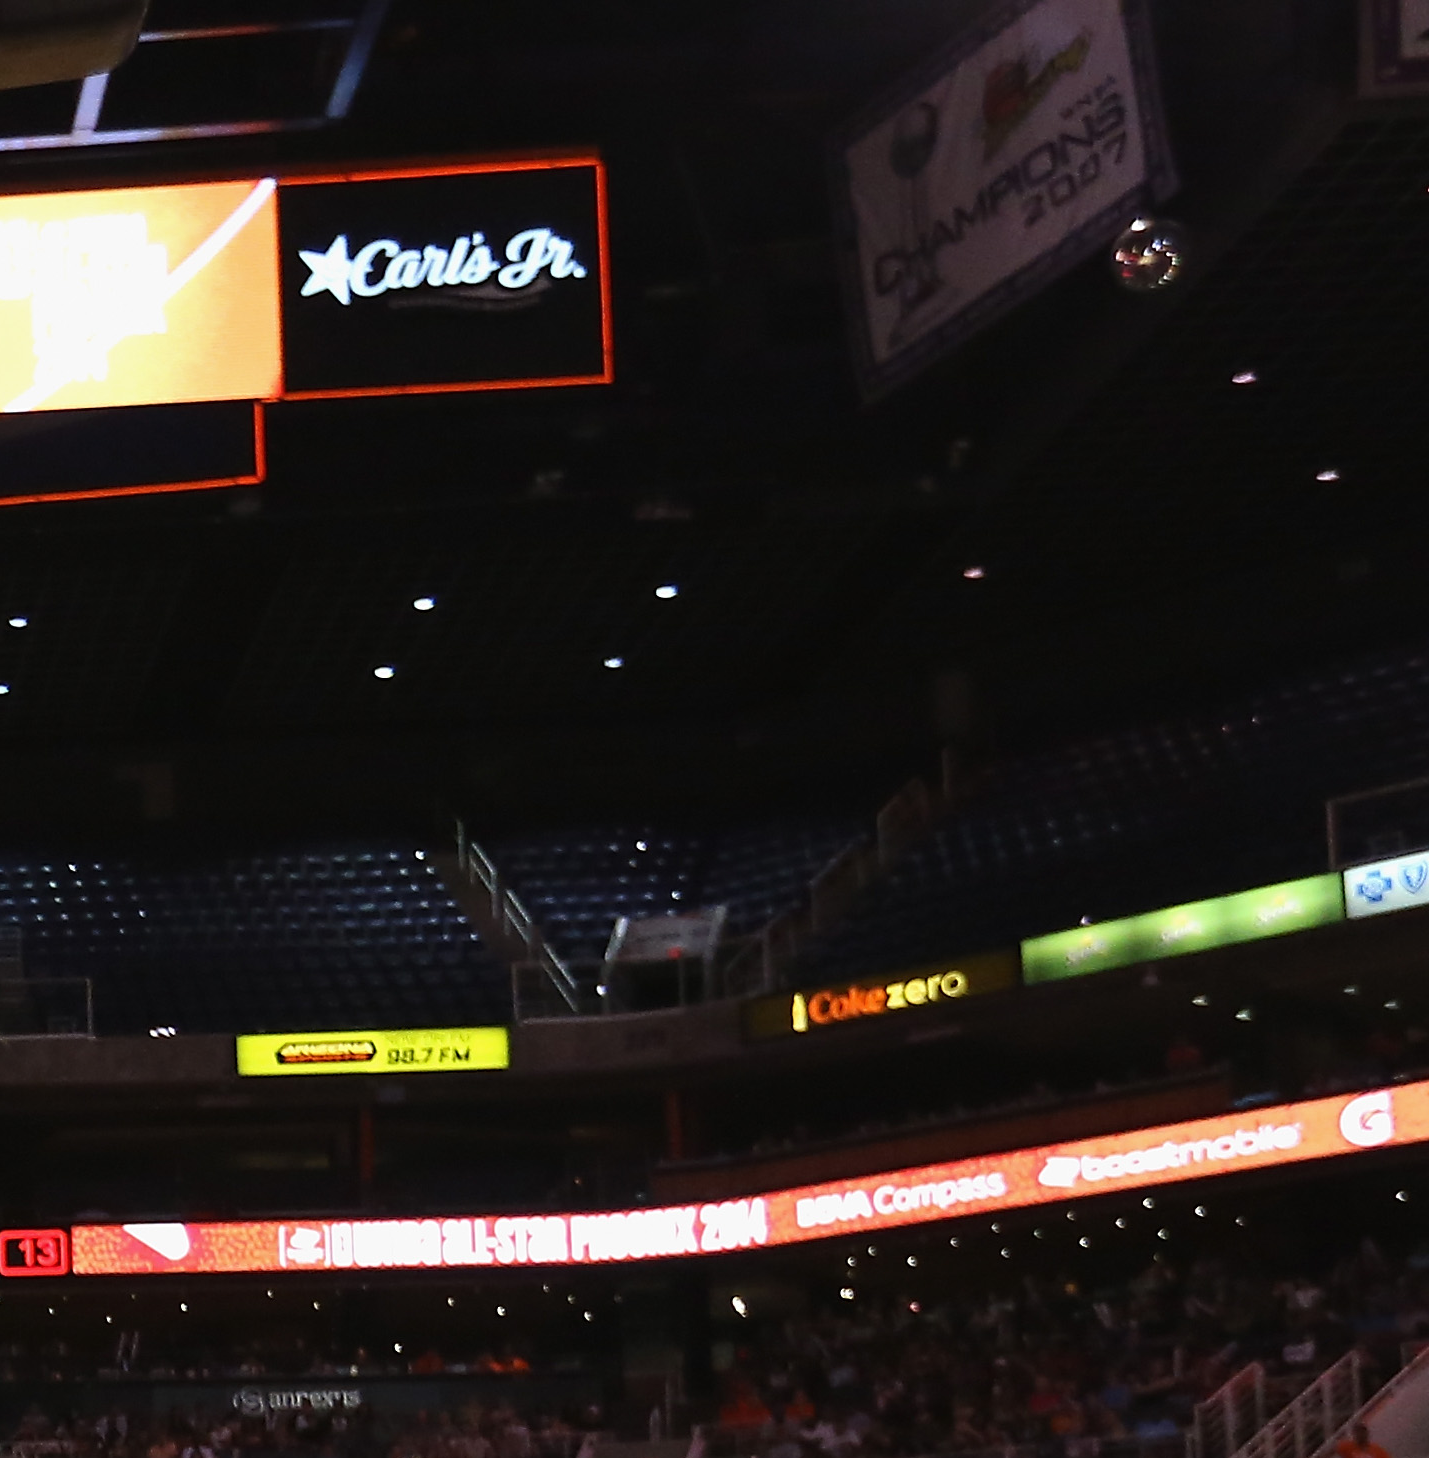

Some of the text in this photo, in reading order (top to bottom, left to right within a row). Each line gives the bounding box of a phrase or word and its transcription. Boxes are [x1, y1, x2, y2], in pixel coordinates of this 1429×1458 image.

[873, 103, 1126, 299] CHAMPIONS
[1024, 131, 1127, 229] 2007
[497, 226, 588, 289] Jr.
[439, 1046, 472, 1063] FM
[17, 1238, 56, 1268] 13
